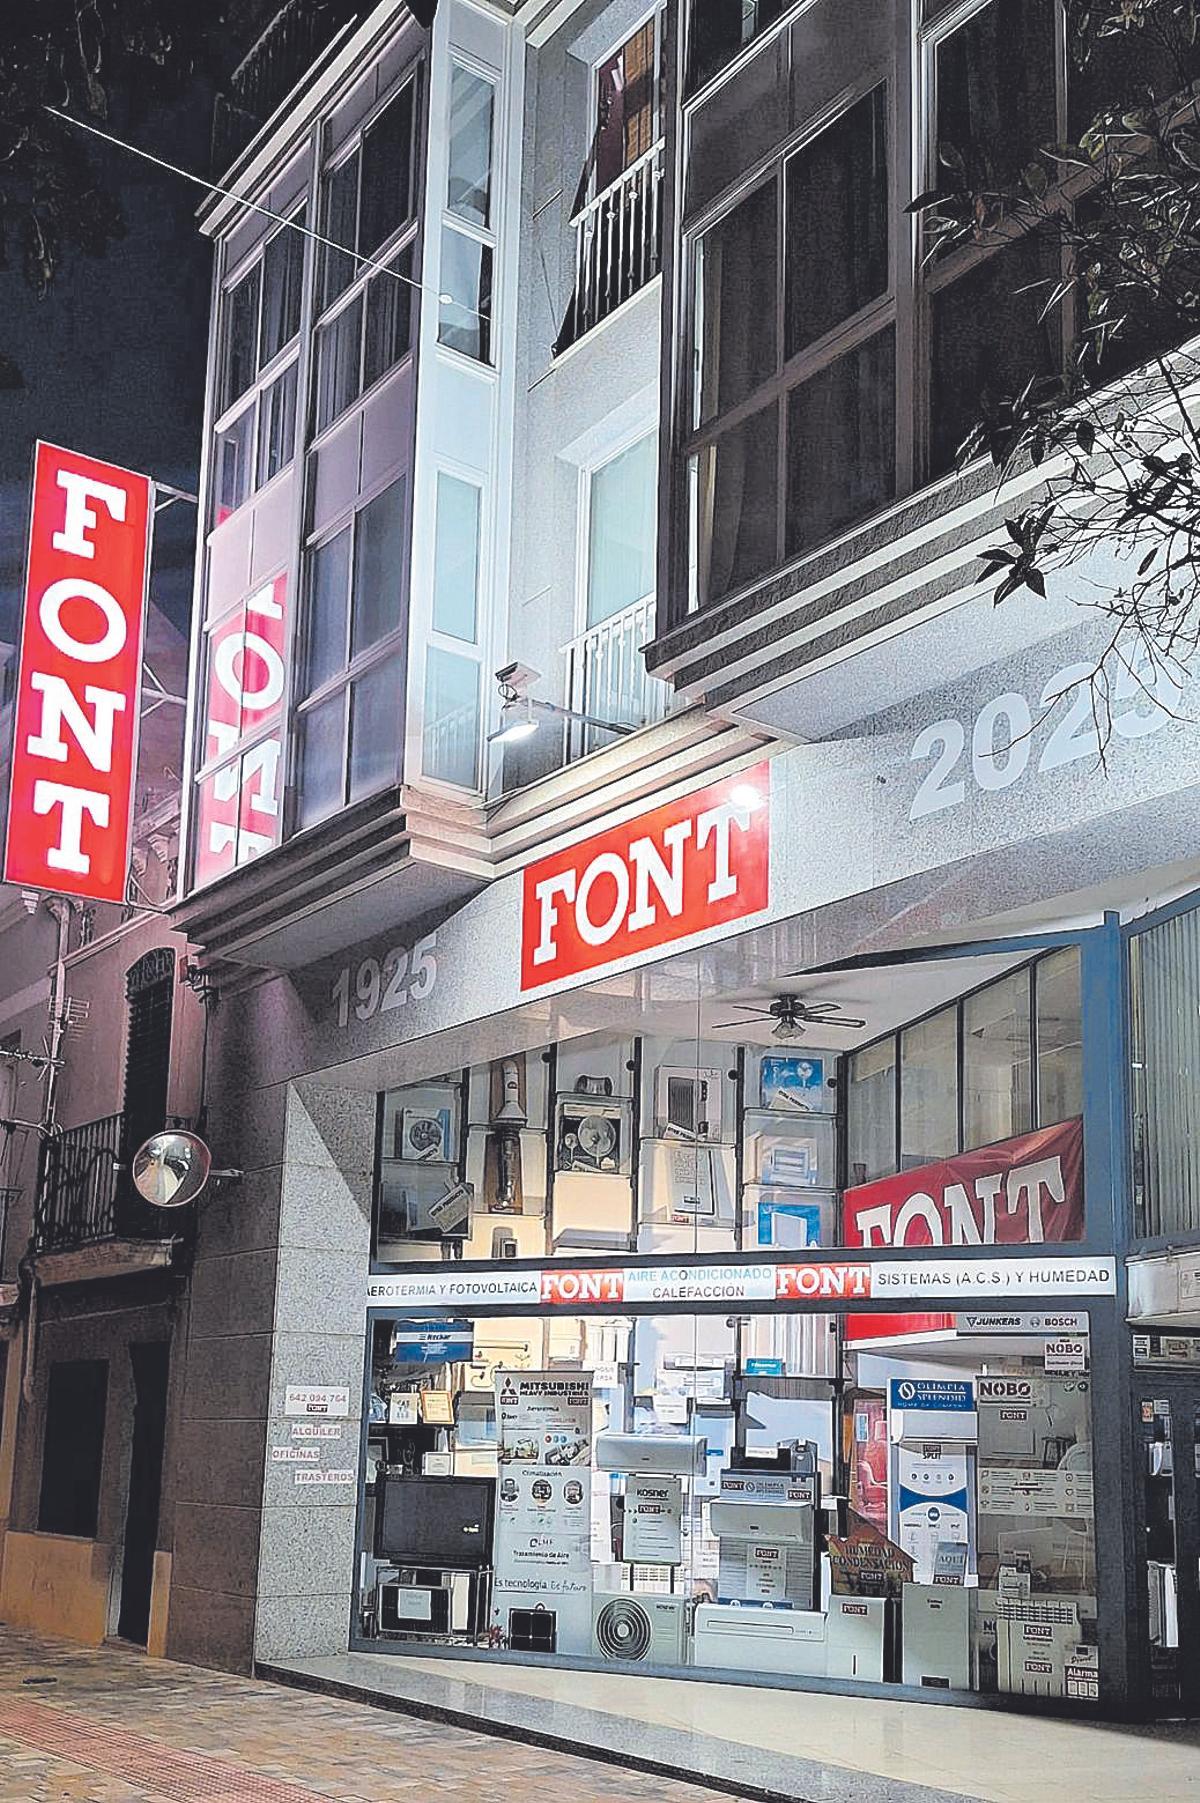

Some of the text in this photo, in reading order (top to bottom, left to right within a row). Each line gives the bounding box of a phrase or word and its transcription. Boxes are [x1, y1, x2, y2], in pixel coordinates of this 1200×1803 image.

[27, 470, 127, 876] FONT
[909, 632, 1182, 821] 2025
[533, 803, 752, 966] FONT
[332, 932, 437, 1028] 1925
[856, 1155, 1065, 1246] FONT
[628, 1267, 772, 1282] AIRE ACONDICIONADO
[776, 1266, 871, 1295] FONT
[878, 1272, 950, 1286] SISTEMAS
[1015, 1272, 1024, 1283] Y
[1029, 1269, 1110, 1283] HUMEDAD
[440, 1285, 446, 1295] Y
[450, 1281, 537, 1295] FOTOVOLTAICA
[541, 1270, 624, 1300] FONT
[976, 1317, 1021, 1326] JUNKERS
[1044, 1318, 1077, 1326] BOSCH
[520, 1382, 589, 1391] MITSUBISHI
[980, 1382, 1031, 1397] NOBO
[272, 1450, 319, 1459] OFICINAS
[296, 1473, 353, 1482] TRASTEROS
